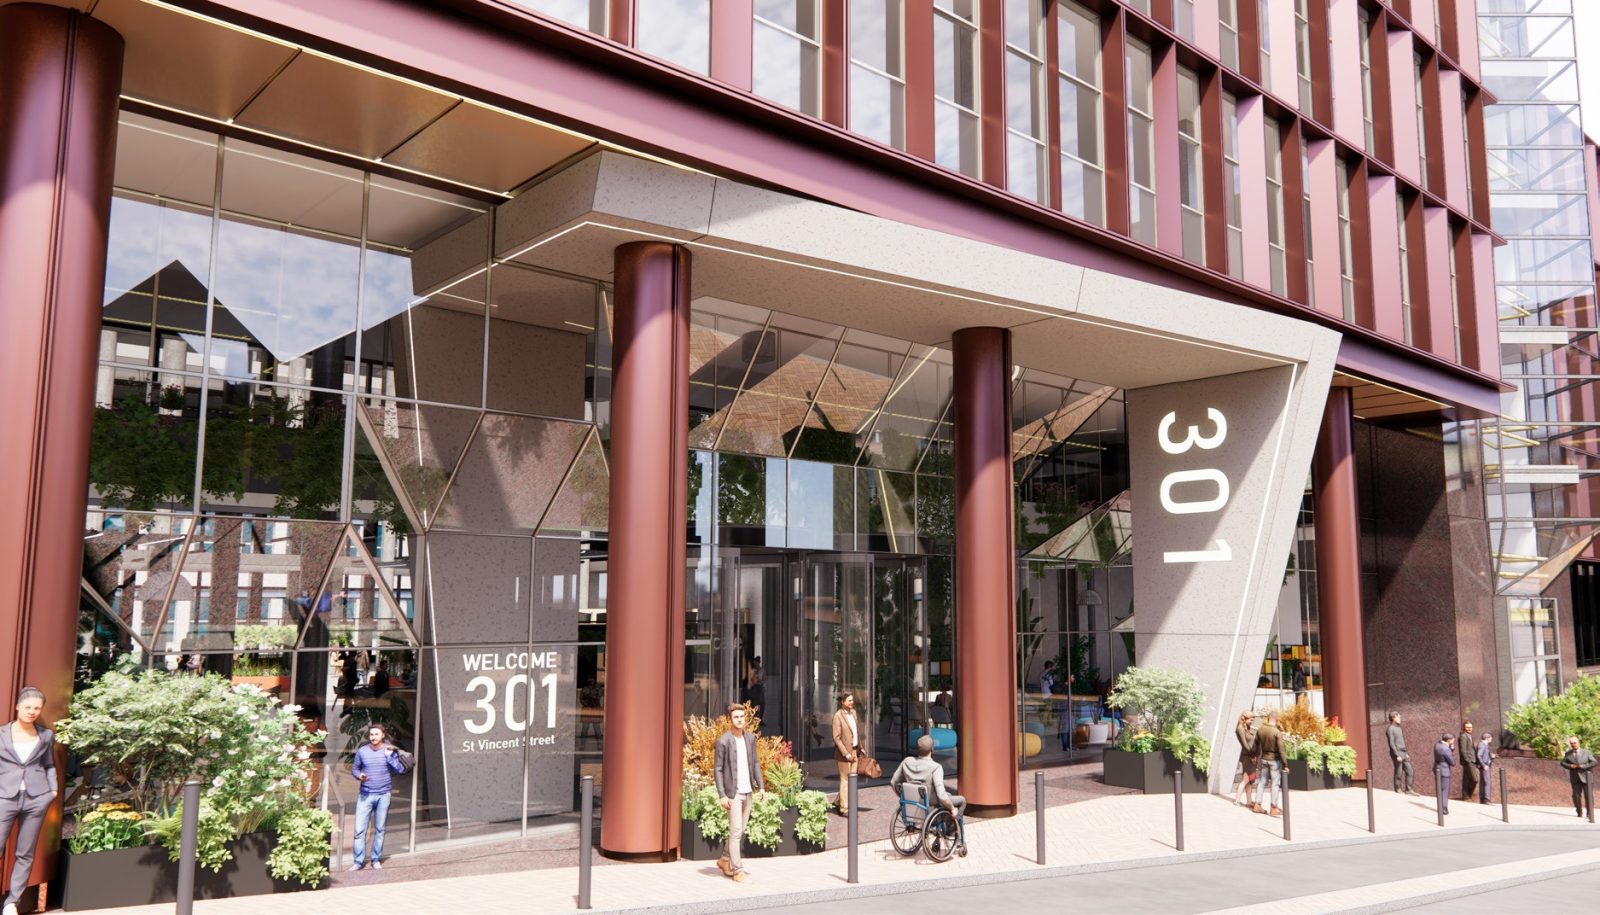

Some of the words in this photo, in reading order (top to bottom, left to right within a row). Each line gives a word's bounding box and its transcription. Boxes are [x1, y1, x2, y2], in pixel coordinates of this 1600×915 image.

[1157, 407, 1233, 563] 301
[462, 652, 558, 671] WELCOME
[463, 673, 558, 734] 301
[462, 740, 475, 752] St
[478, 737, 520, 751] Vincent
